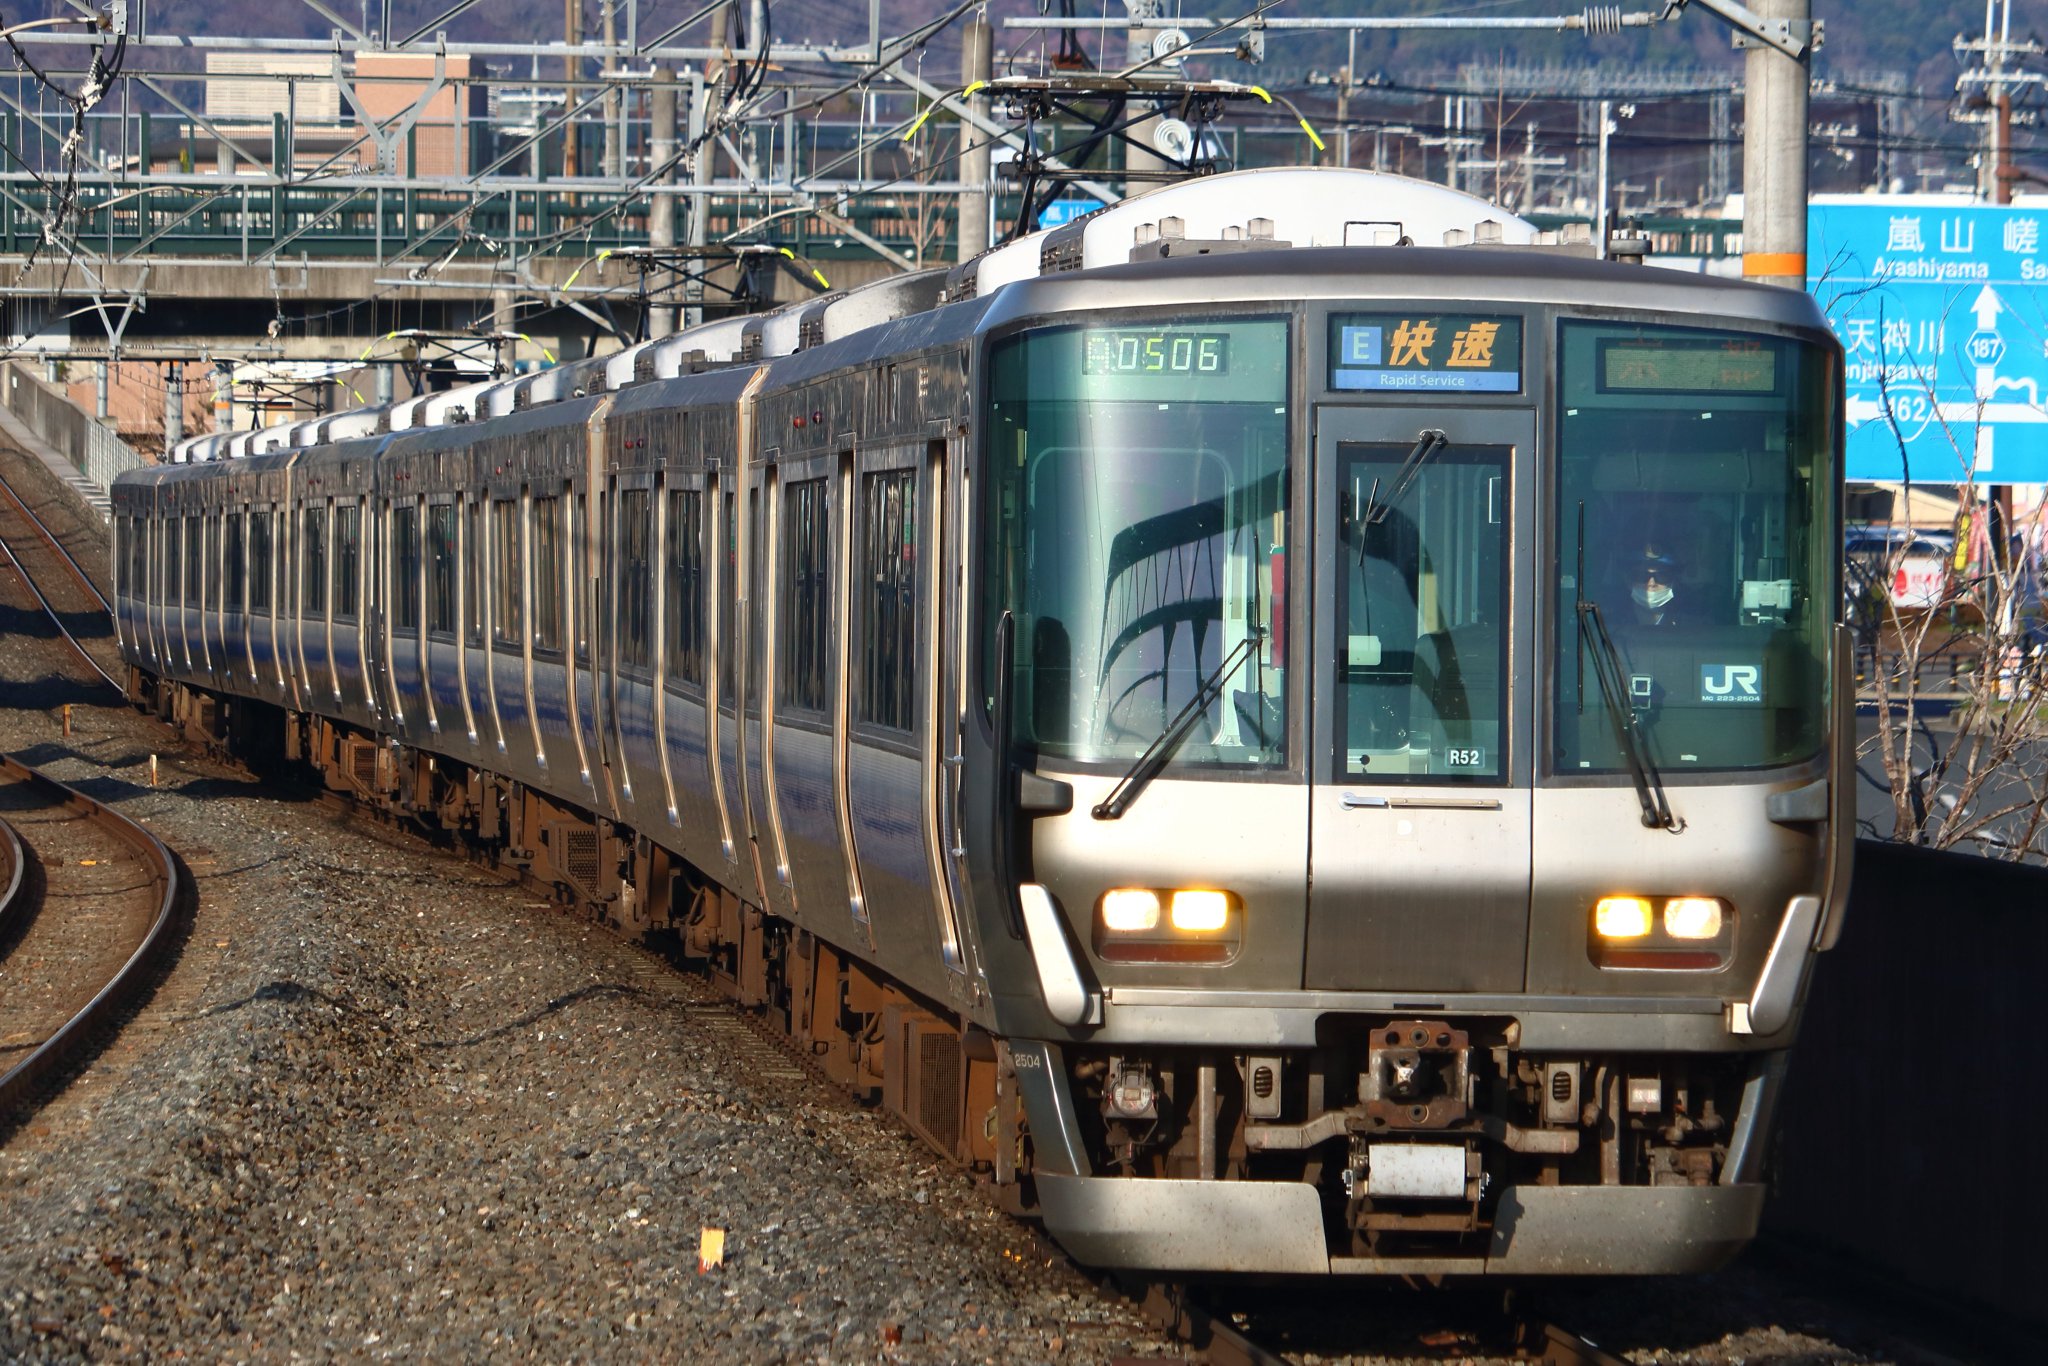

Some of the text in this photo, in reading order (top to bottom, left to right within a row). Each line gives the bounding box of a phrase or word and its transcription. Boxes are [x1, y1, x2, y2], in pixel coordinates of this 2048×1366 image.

[1886, 215, 1975, 253] 嵐山
[1872, 256, 2048, 282] Arashiyama Sa
[1353, 332, 1370, 360] E
[1389, 320, 1501, 368] 快速
[1828, 318, 1945, 355] 天神川
[1972, 338, 2000, 358] 187
[1380, 374, 1465, 388] Rapid Service
[1844, 361, 1938, 383] njingawa
[1888, 395, 1926, 422] 162
[1705, 665, 1758, 694] JR
[1450, 749, 1480, 765] R52
[1014, 1053, 1041, 1069] 2504
